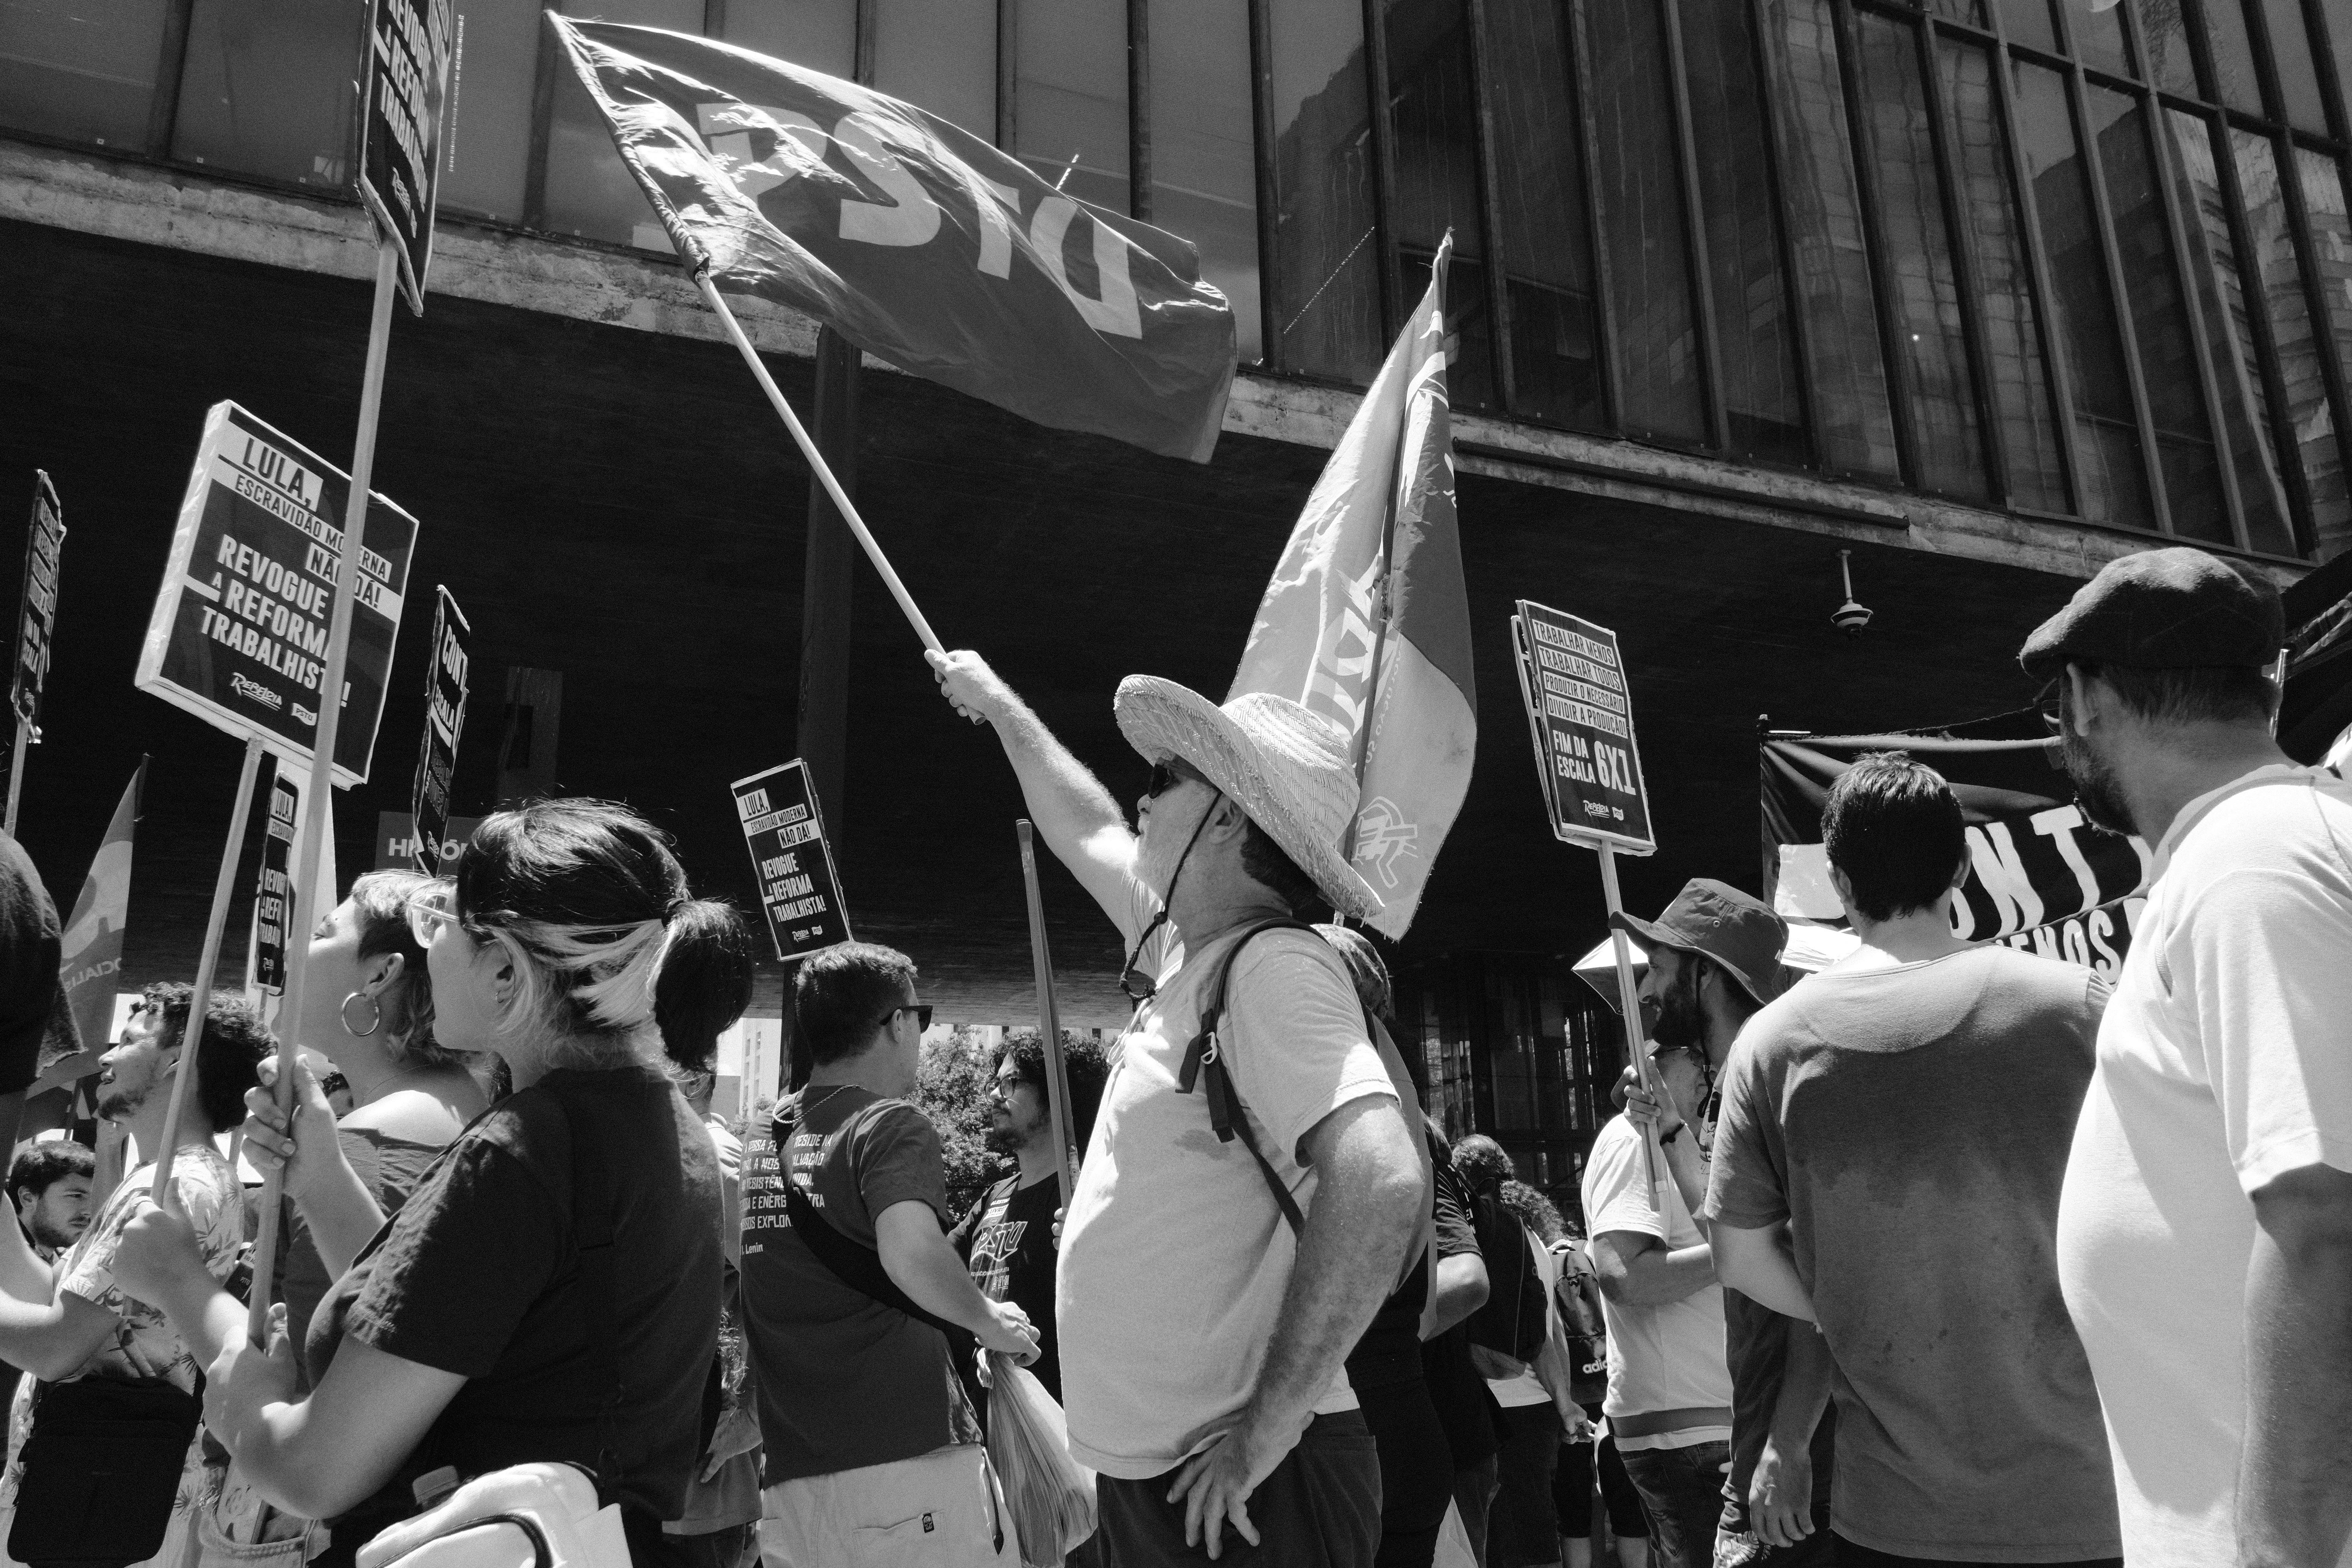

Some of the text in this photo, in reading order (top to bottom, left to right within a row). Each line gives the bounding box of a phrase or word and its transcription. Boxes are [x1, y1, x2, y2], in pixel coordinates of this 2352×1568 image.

[243, 437, 312, 508] LULA,
[235, 474, 386, 579] ESCRAVIDÃO MORNA
[211, 572, 222, 589] A
[217, 534, 329, 619] REVOGUE
[201, 605, 351, 707] TRABALHIST!
[1534, 622, 1614, 665] TRABALHAR MENOS
[1539, 648, 1621, 690] TRABALHAR TODOS
[435, 684, 454, 731] ESCALA
[1545, 674, 1623, 712] PRODUZIR O NECESSÁRIO
[1548, 697, 1627, 737] DIVIDIR A PRODUÇÃO!
[1553, 730, 1589, 759] FIM DA
[1556, 755, 1596, 784] ESCALA
[1594, 741, 1636, 795] 6X1
[744, 792, 769, 816] LULA,
[750, 806, 805, 833] ESCRAVIDÃO MODERNA
[779, 823, 811, 847] NÃO DÁ!
[762, 852, 799, 880] REVOGUE
[768, 873, 814, 901] A REFORMA
[773, 894, 827, 922] TRABALHISTA!
[792, 1151, 825, 1169] ALVAÇÃO
[752, 1196, 757, 1210] E
[758, 1193, 787, 1209] ENÉRG
[806, 1193, 825, 1208] TRA
[746, 1242, 763, 1255] Lenin
[974, 1221, 1028, 1255] PSTU
